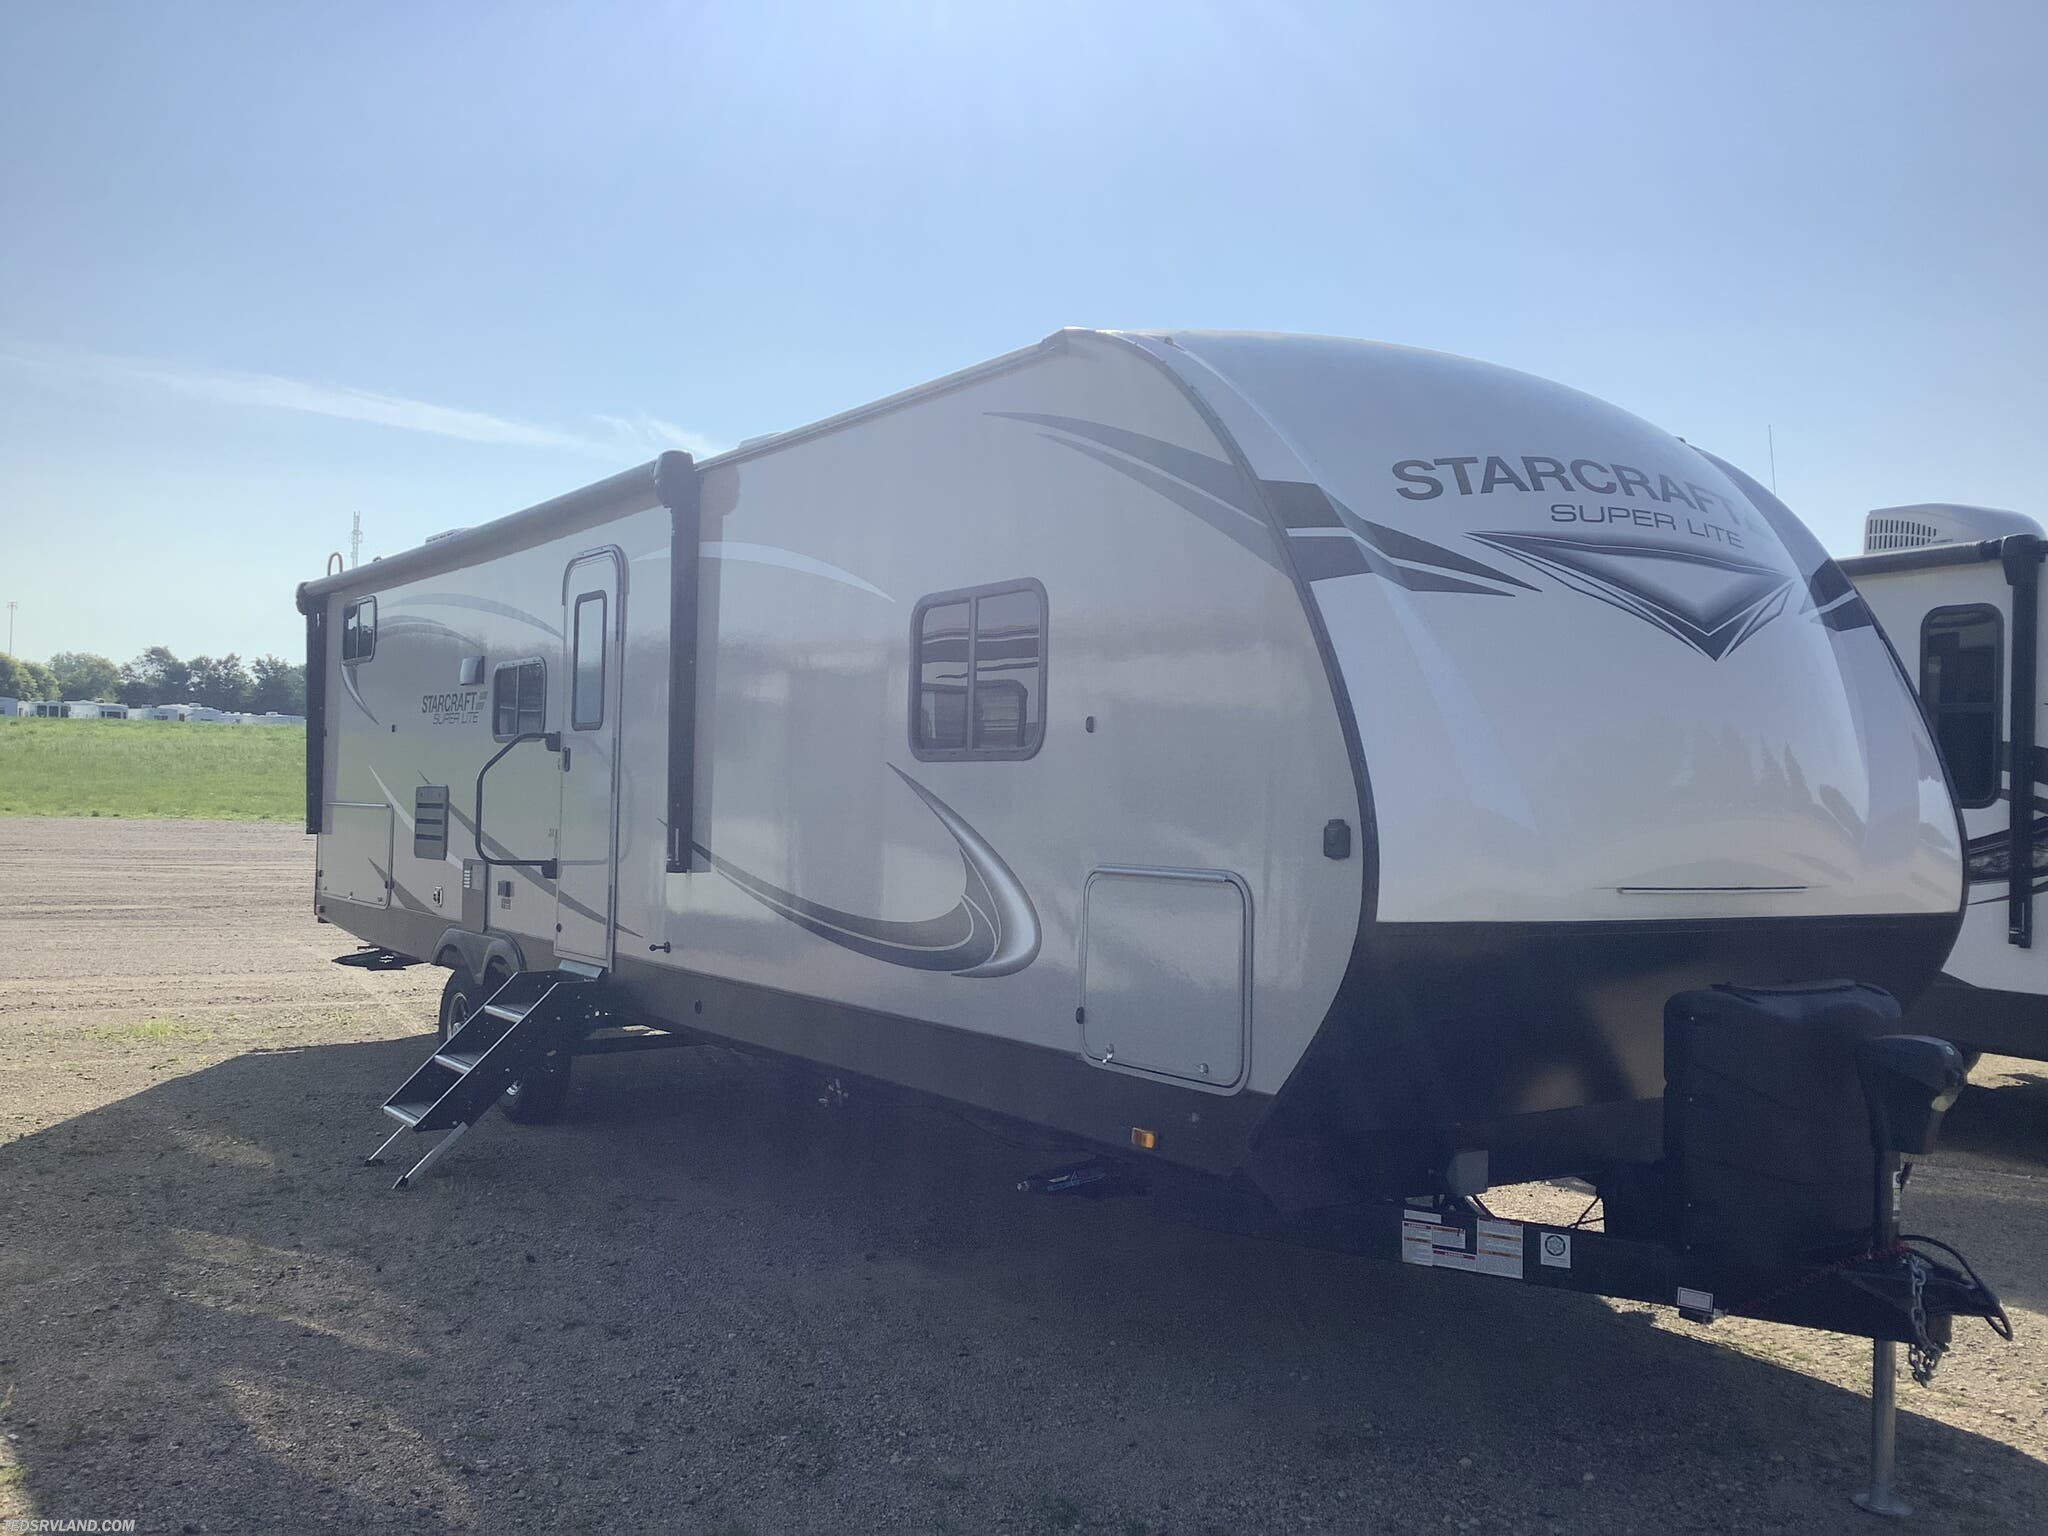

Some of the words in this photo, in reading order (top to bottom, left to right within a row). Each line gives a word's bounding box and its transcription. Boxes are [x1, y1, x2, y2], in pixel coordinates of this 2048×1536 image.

[1391, 455, 1741, 526] STARCRAFT
[1550, 503, 1677, 531] SUPER
[1687, 518, 1745, 549] LITE
[422, 692, 477, 713] STARCRAFT
[433, 713, 460, 725] SUPER
[461, 711, 479, 724] LITE
